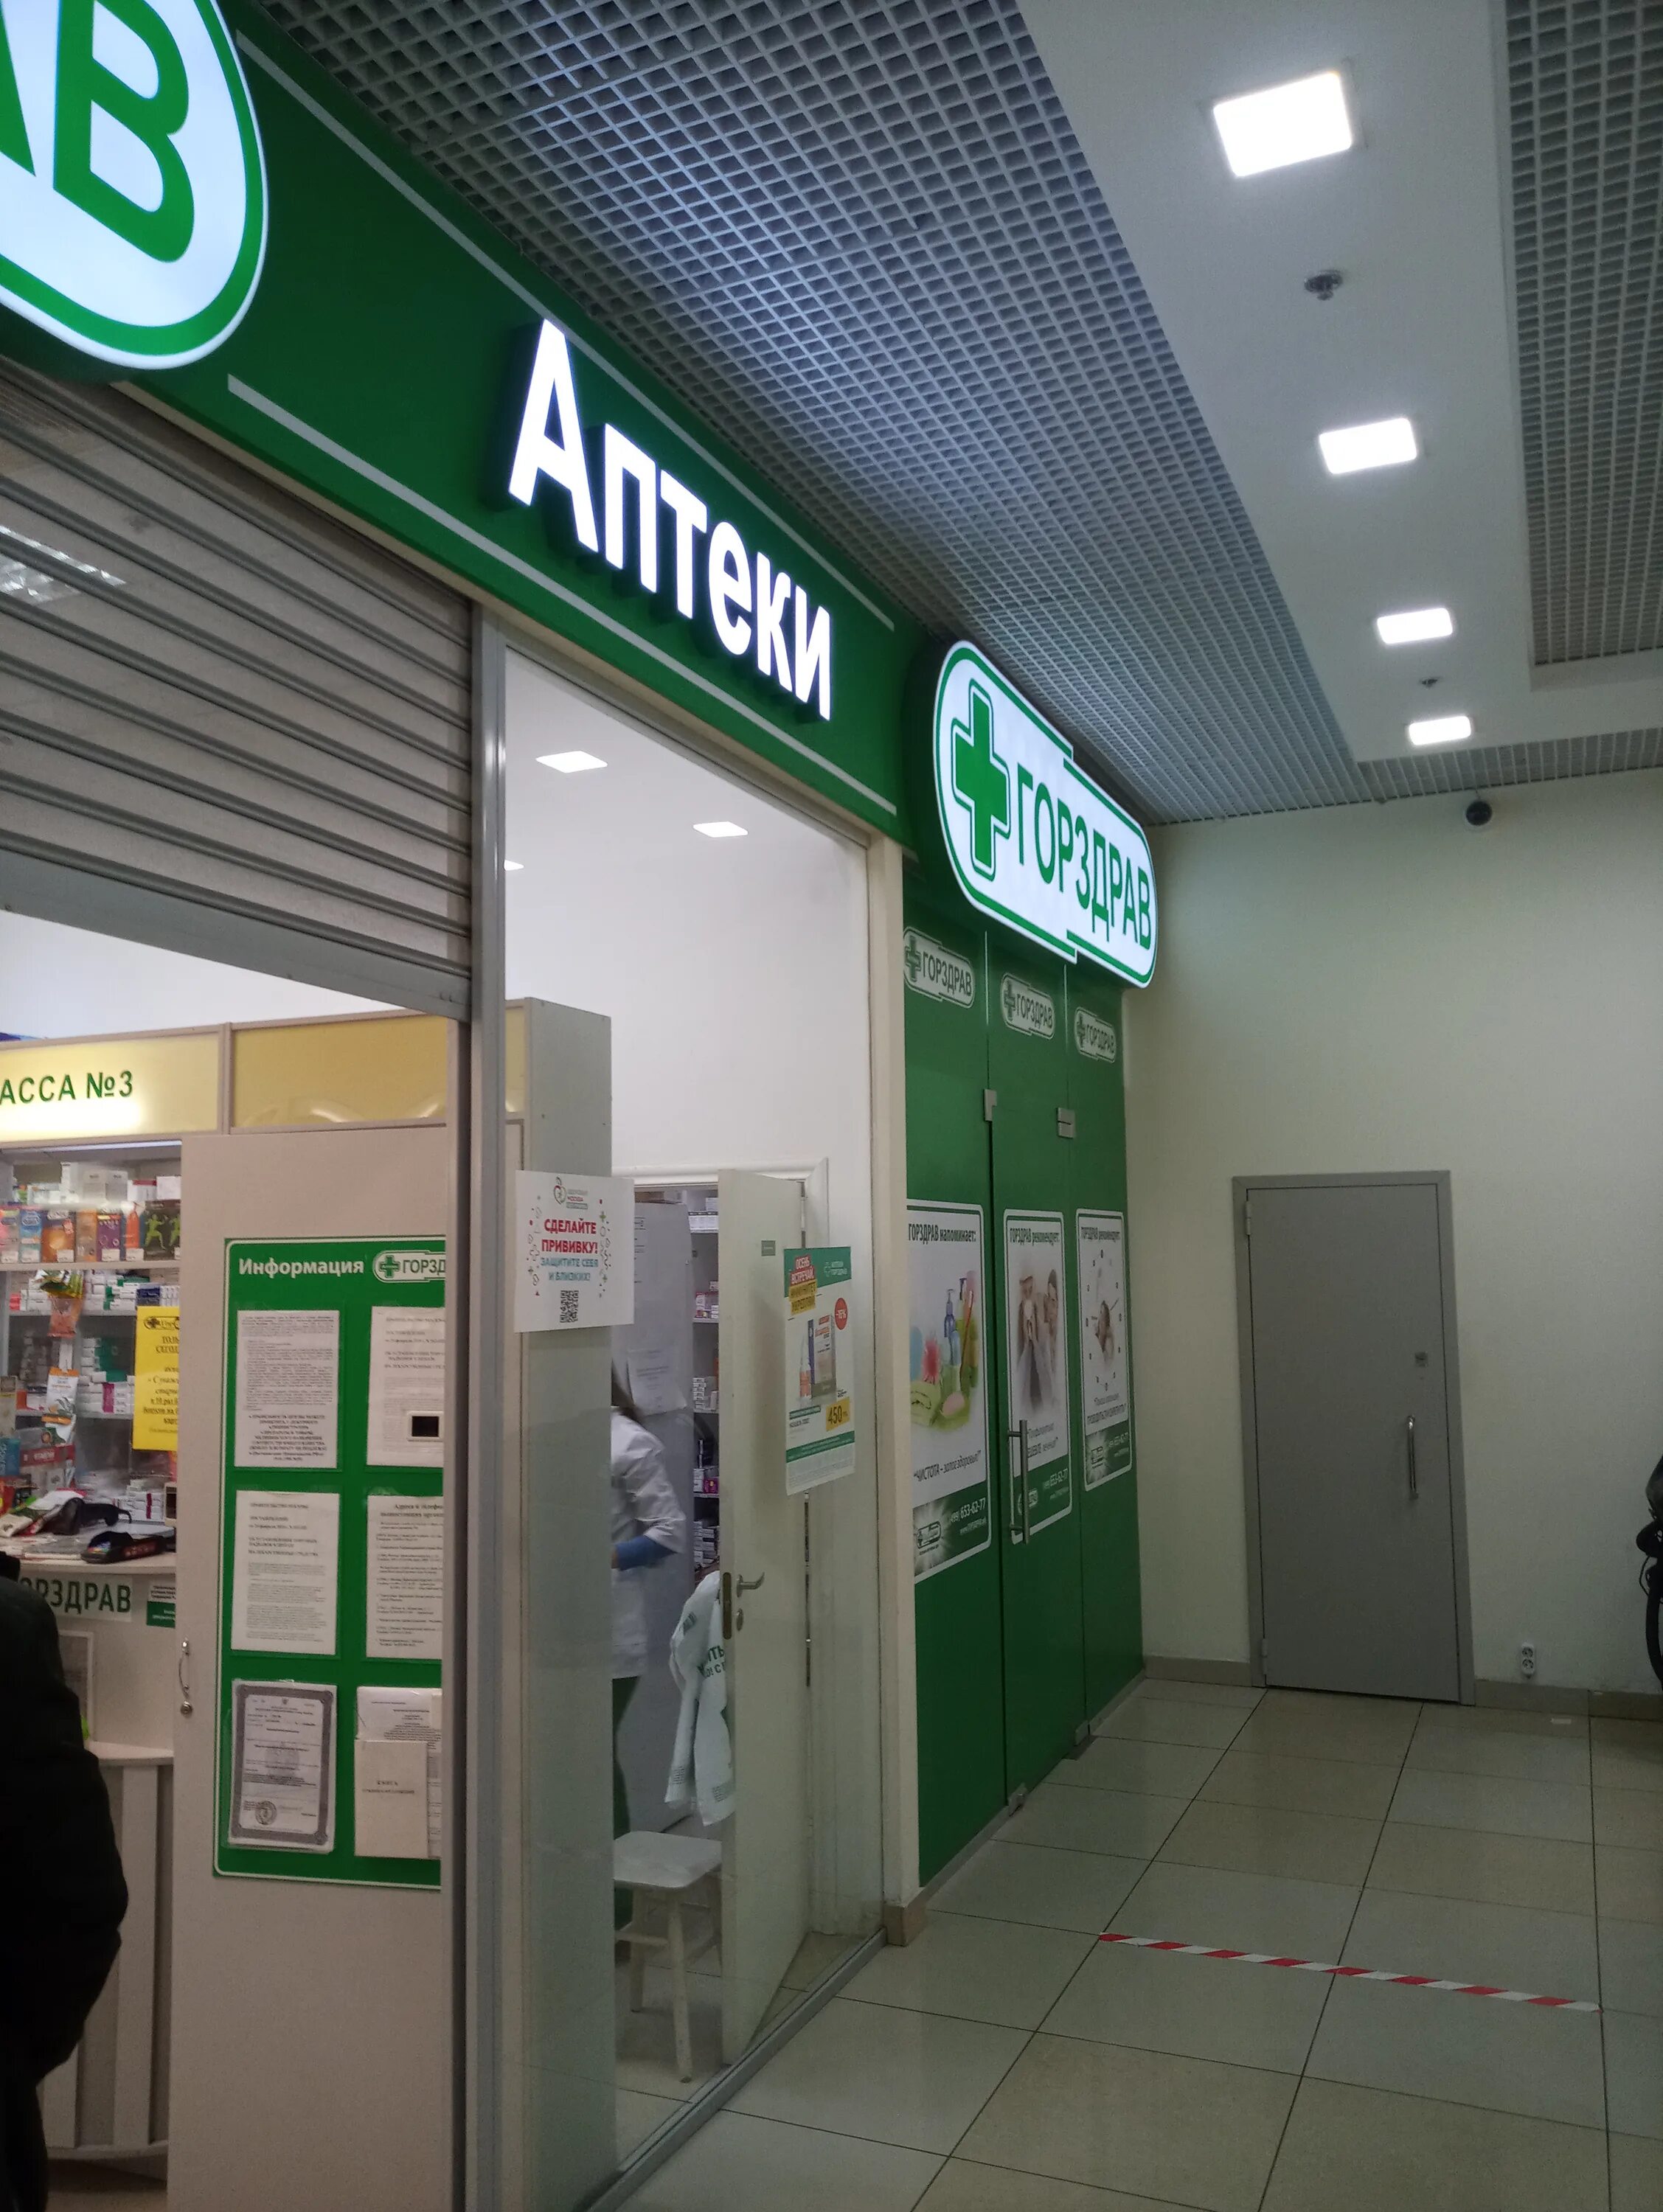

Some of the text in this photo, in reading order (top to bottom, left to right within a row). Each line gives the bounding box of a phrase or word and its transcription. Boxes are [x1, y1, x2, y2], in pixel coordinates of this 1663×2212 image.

[508, 319, 831, 721] Аптеки
[1016, 760, 1153, 951] ГОРЗДРАВ
[923, 951, 972, 997] ГОРЗДРАВ
[1015, 992, 1053, 1029] ГОРЗДРАВ
[1086, 1024, 1115, 1055] ГОРЗДРАВ
[86, 1070, 133, 1099] №3
[544, 1217, 597, 1234] СДЕЛАЙТЕ
[908, 1223, 976, 1245] ГОРЗДРАВ напоминает:
[1010, 1228, 1031, 1245] ГОРЗДРАВ
[541, 1239, 598, 1254] ПРИВИВКУ!
[239, 1257, 364, 1279] Информация
[541, 1256, 599, 1267] ЗАЩИТИТЕ СЕБЯ
[828, 1406, 842, 1425] 450
[960, 1497, 986, 1520] 653-62-77
[21, 1577, 131, 1615] РЗДРАВ
